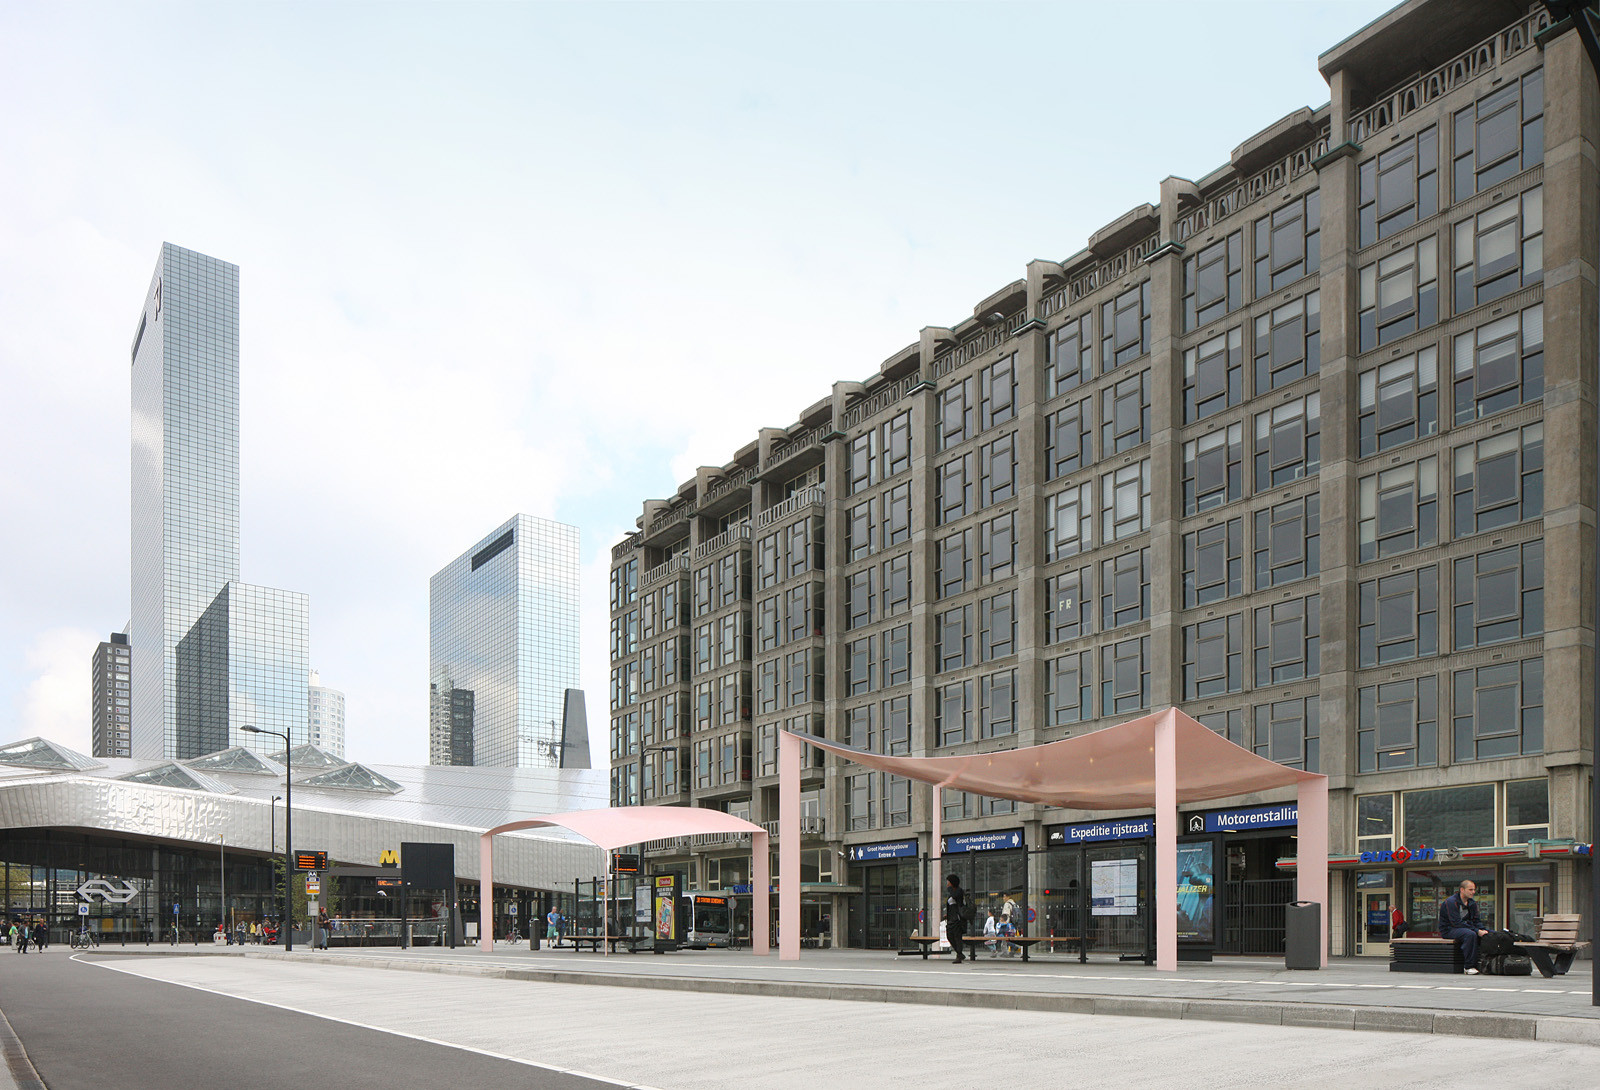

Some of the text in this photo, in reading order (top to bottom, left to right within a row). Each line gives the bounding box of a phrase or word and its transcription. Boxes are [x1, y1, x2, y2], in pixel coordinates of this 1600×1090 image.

[1217, 809, 1298, 826] Motorenstallin
[1071, 822, 1149, 840] Expeditie rijstraat
[970, 834, 1007, 843] Handelsgebouw
[1176, 884, 1208, 893] UALIZER
